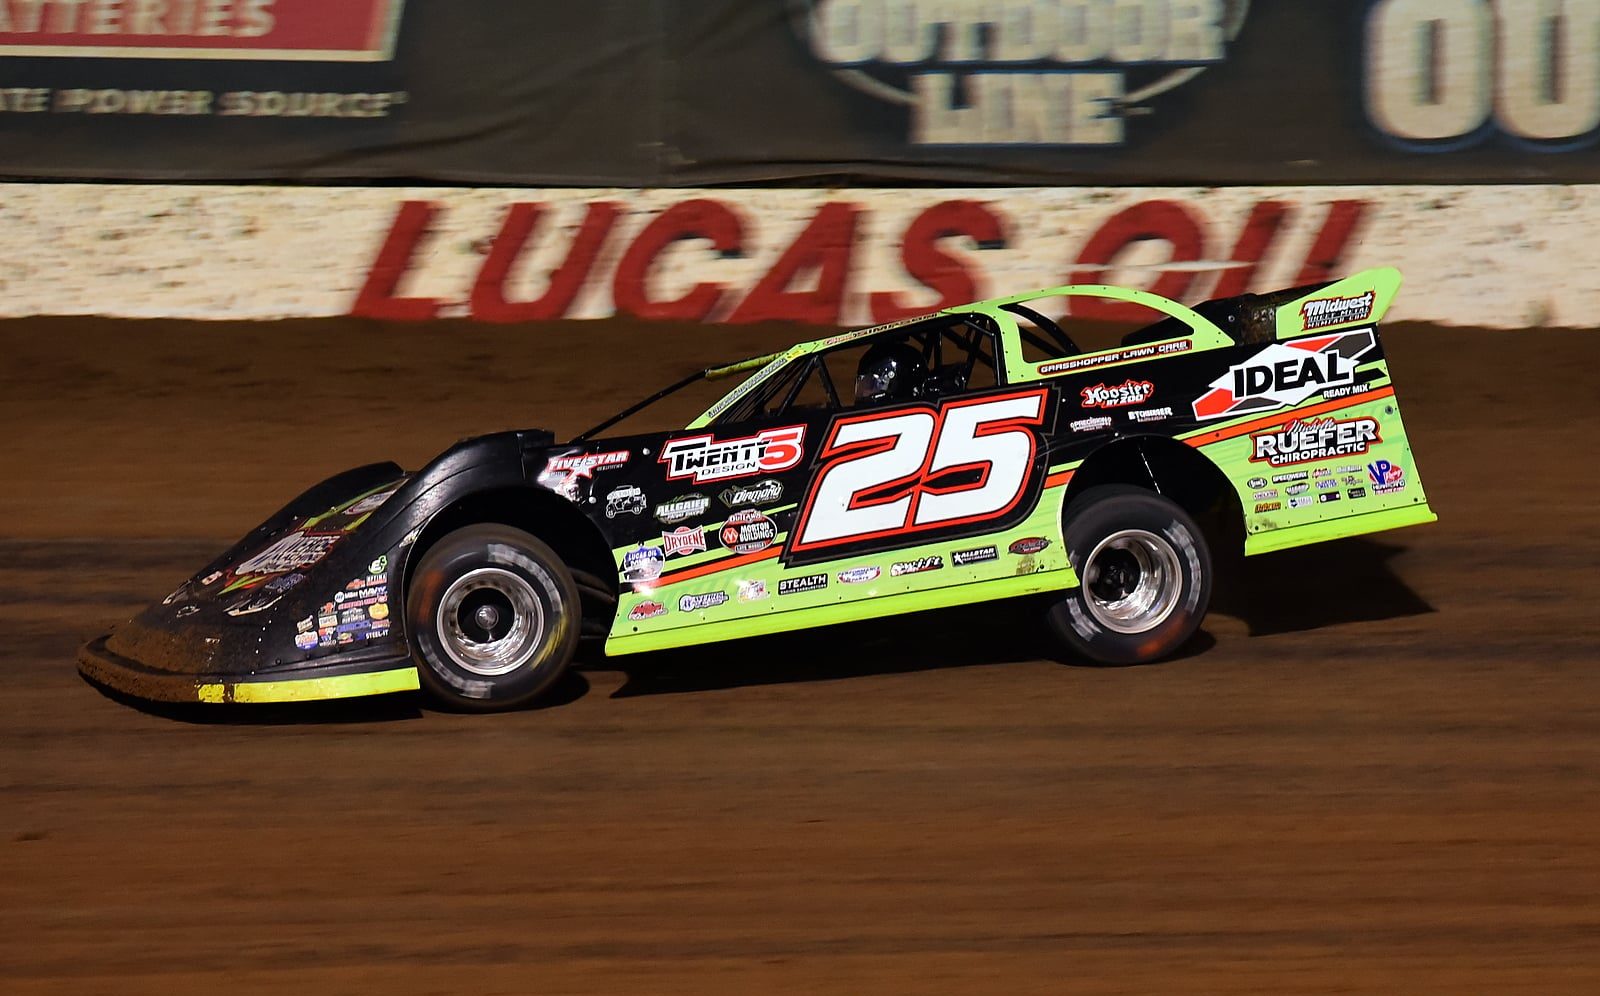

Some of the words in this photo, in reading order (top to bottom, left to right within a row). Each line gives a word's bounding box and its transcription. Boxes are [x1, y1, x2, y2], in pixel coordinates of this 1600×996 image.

[812, 0, 1225, 63] OUTDOOR
[53, 88, 213, 115] POWER
[911, 73, 1124, 144] LINE
[348, 199, 1010, 323] LUCAS
[1041, 354, 1119, 373] GRASSHOPPER
[1123, 347, 1155, 359] LAWN
[1234, 352, 1349, 398] IDEAL
[1085, 383, 1150, 404] Hoosier
[1323, 387, 1350, 399] READY
[1352, 384, 1368, 394] MIX
[1256, 420, 1377, 458] RUEFER
[1271, 442, 1365, 464] CHIROPRACTIC
[701, 461, 756, 476] DESIGN
[798, 393, 1044, 547] 25
[740, 522, 770, 534] MORTON
[665, 529, 704, 552] DRYDENE
[628, 551, 646, 560] LUCAS
[648, 549, 658, 557] OIL
[780, 574, 827, 590] STEALTH
